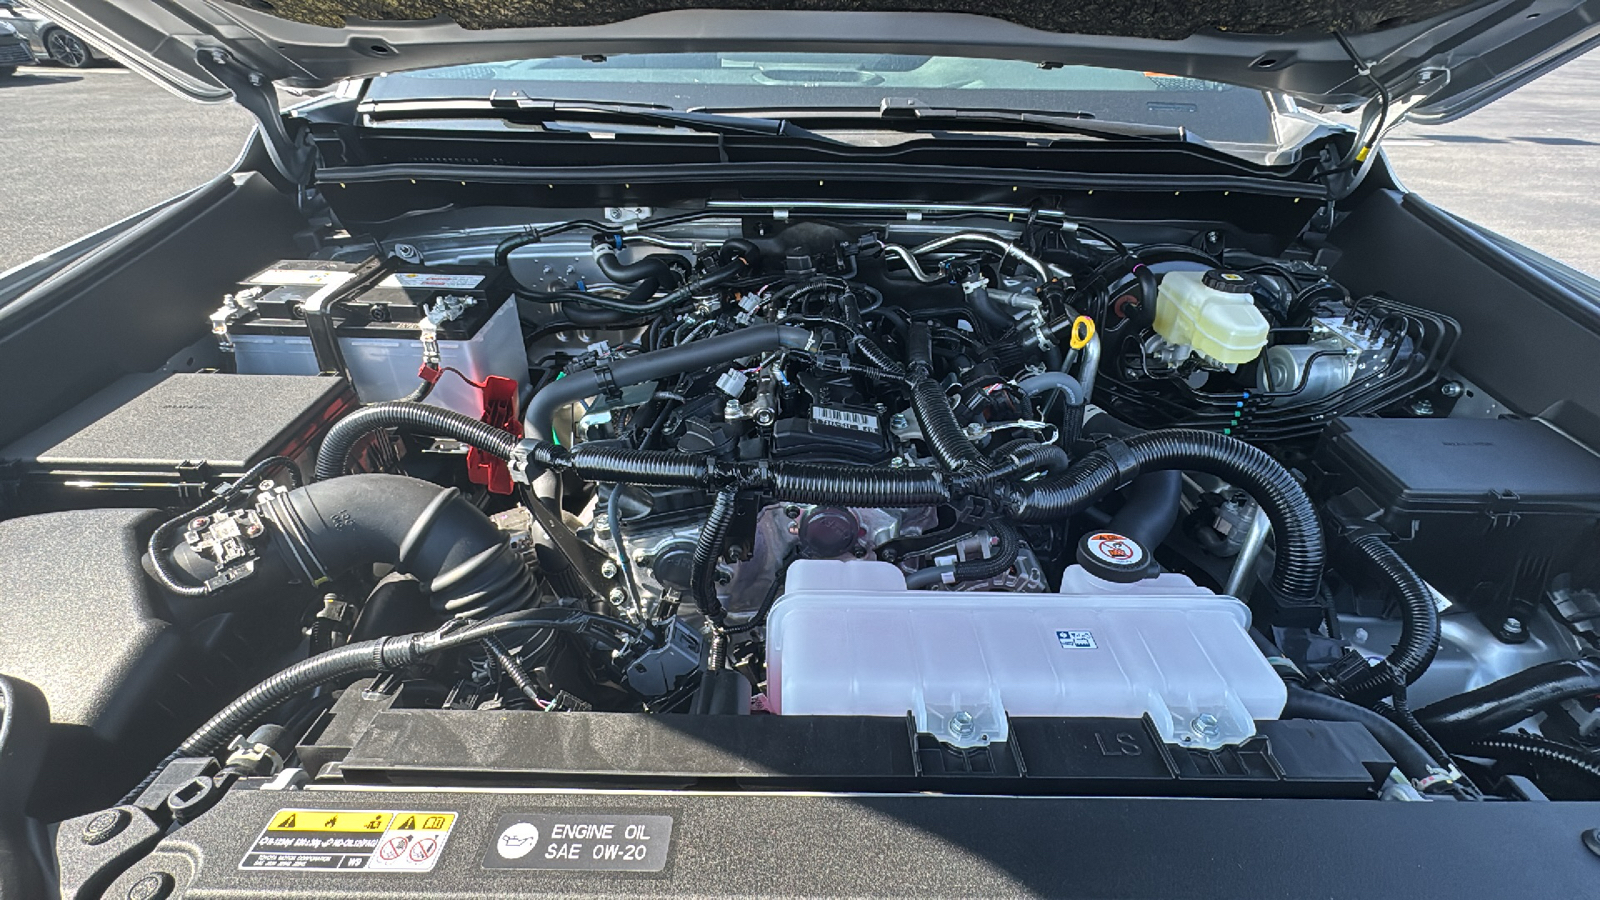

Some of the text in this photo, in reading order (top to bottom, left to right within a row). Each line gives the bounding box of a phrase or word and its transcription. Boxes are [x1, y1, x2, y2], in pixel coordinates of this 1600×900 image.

[1094, 732, 1142, 756] LS
[551, 824, 651, 839] ENGINE OIL
[544, 843, 647, 860] SAE 0W-20
